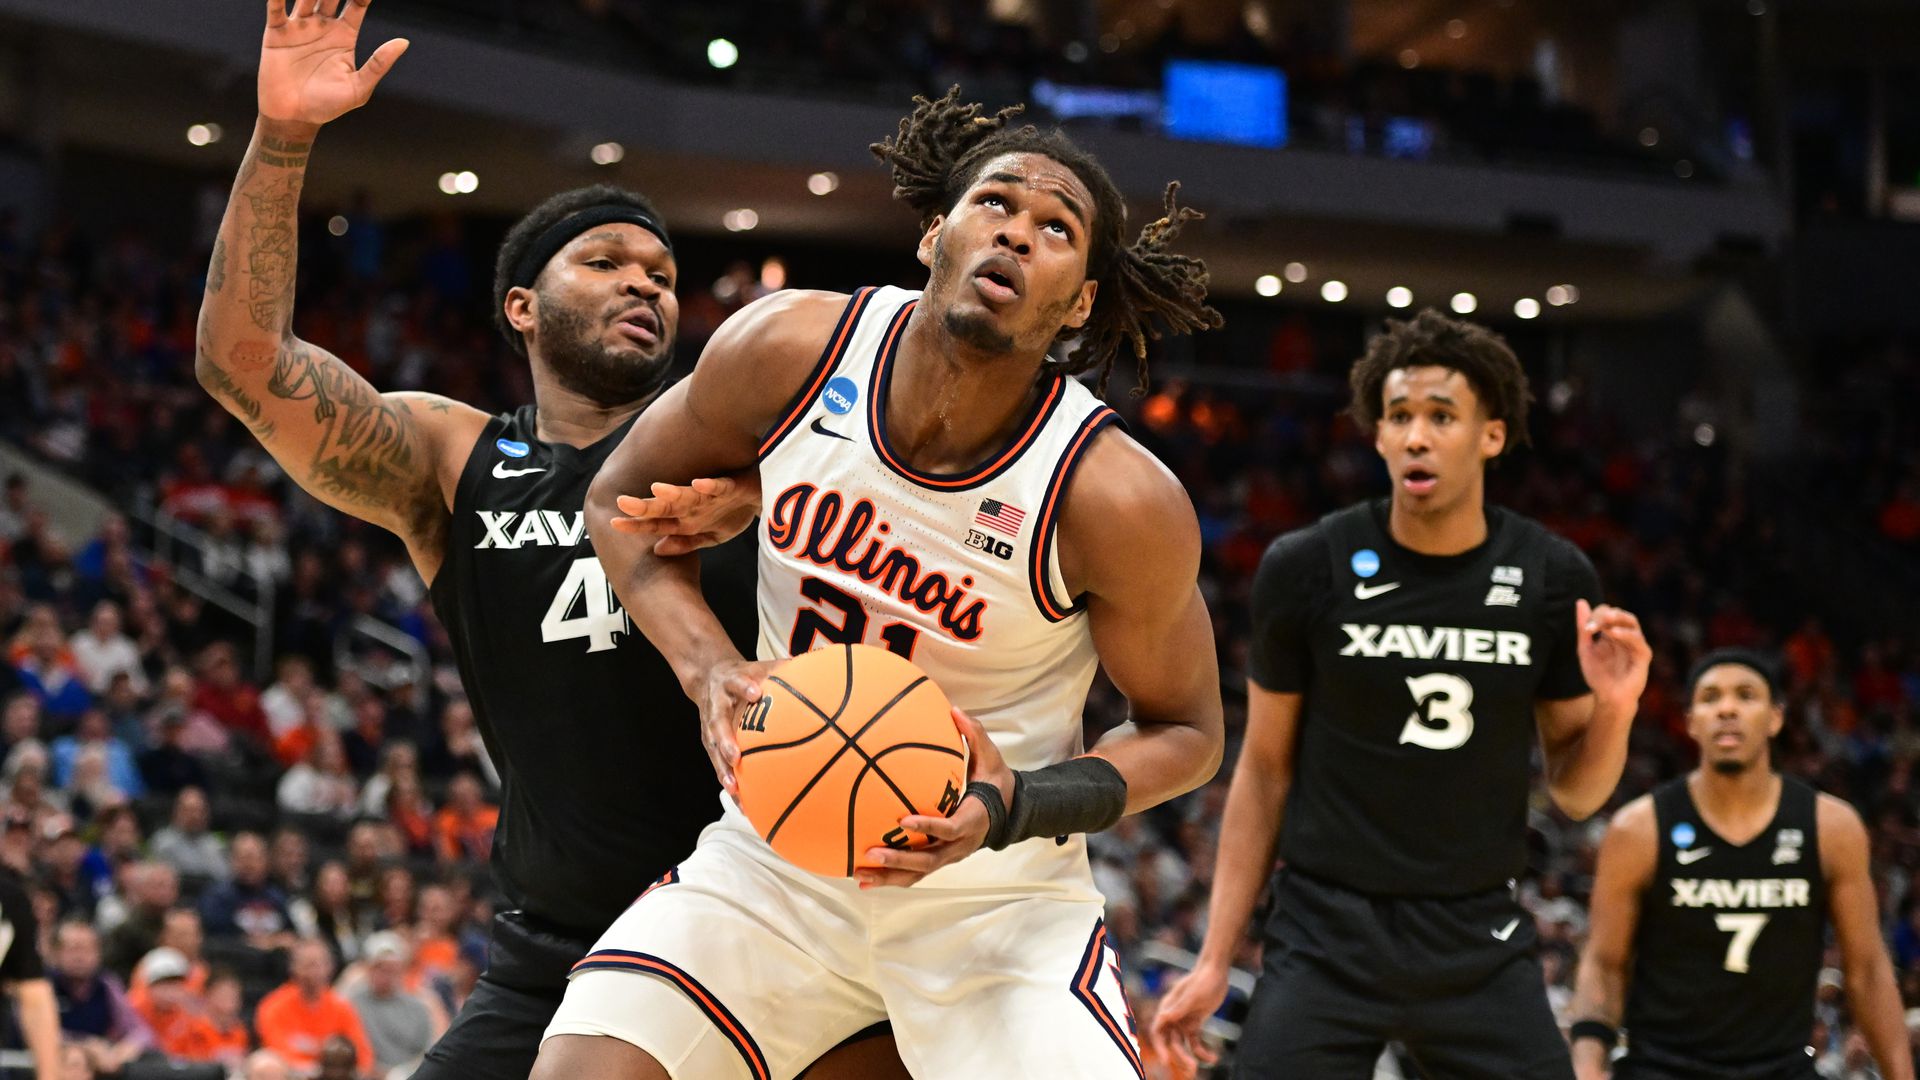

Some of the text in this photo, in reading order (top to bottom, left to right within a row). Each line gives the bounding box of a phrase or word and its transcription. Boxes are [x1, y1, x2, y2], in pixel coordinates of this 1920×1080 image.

[825, 387, 852, 411] NCAA
[474, 509, 591, 549] XAV
[768, 482, 988, 642] Illinois
[541, 556, 630, 653] 4
[1338, 623, 1532, 665] XAVIER
[1399, 673, 1474, 750] 3
[1670, 878, 1810, 908] XAVIER
[1714, 913, 1770, 973] 7
